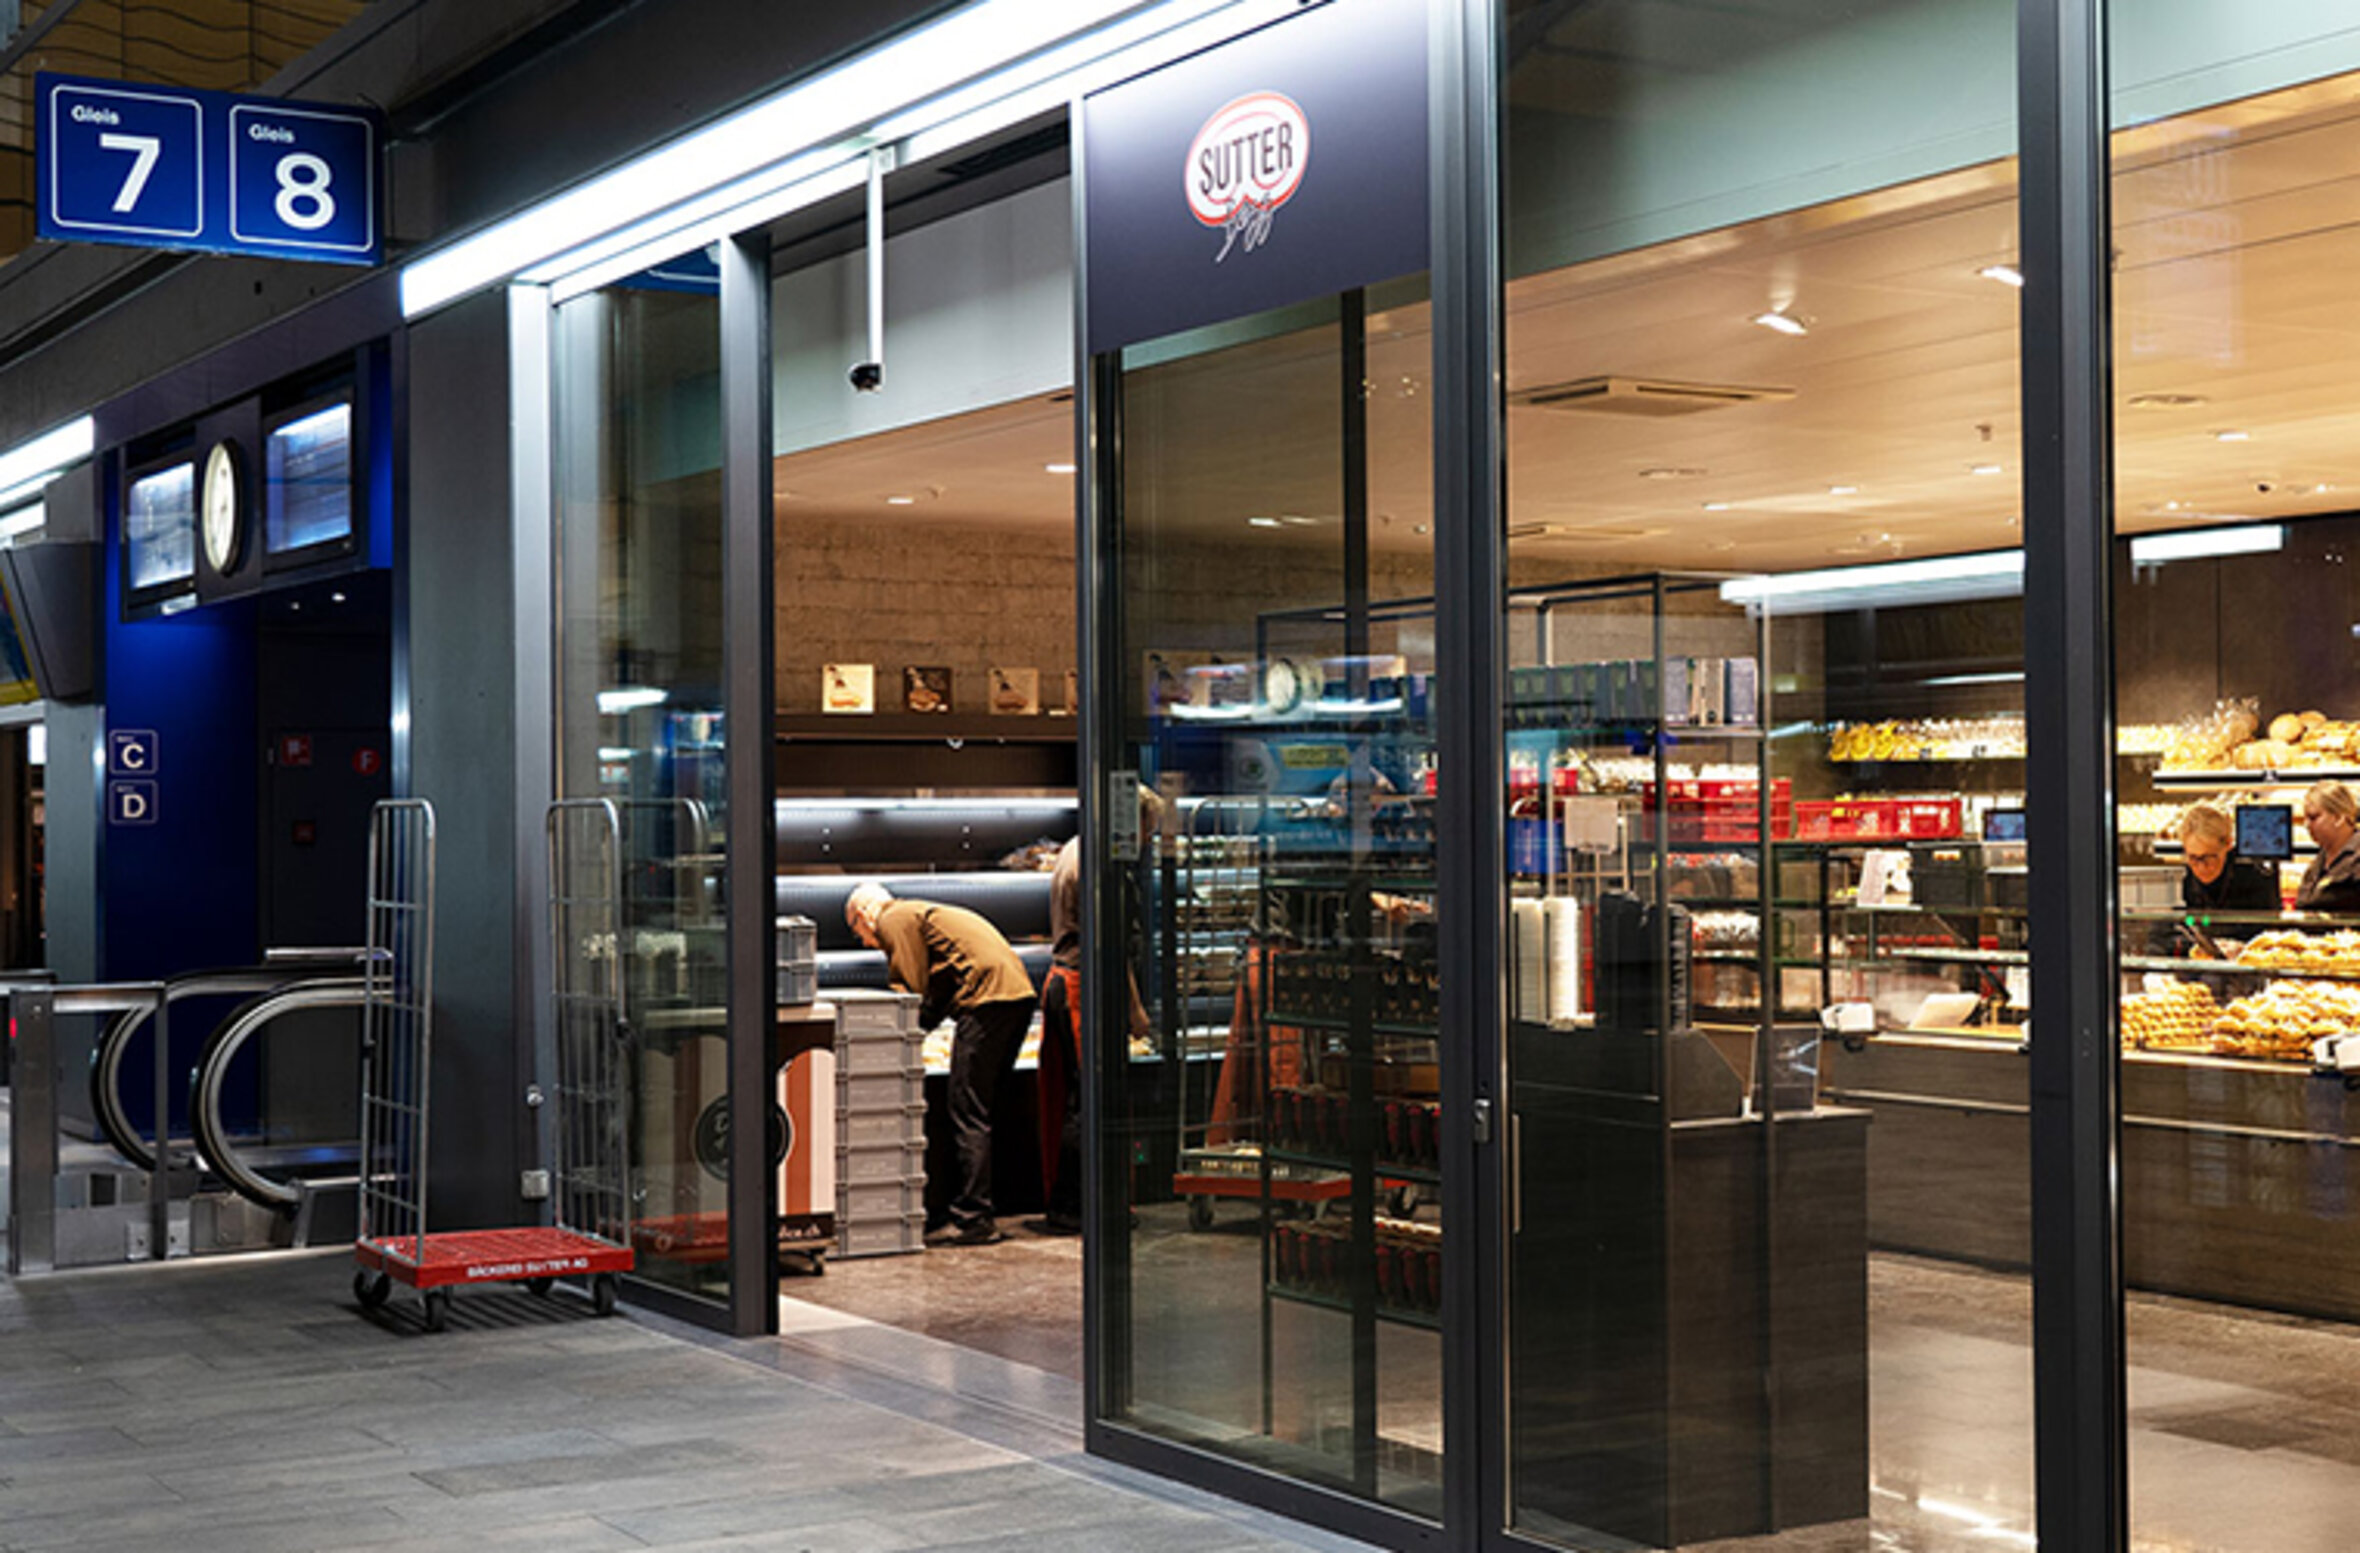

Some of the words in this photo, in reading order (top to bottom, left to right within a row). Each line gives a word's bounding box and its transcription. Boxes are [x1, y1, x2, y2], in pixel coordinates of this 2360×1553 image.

[100, 133, 160, 212] 7
[275, 153, 336, 230] 8
[1199, 121, 1293, 195] SUTTER
[122, 743, 144, 768] C
[123, 794, 146, 818] D
